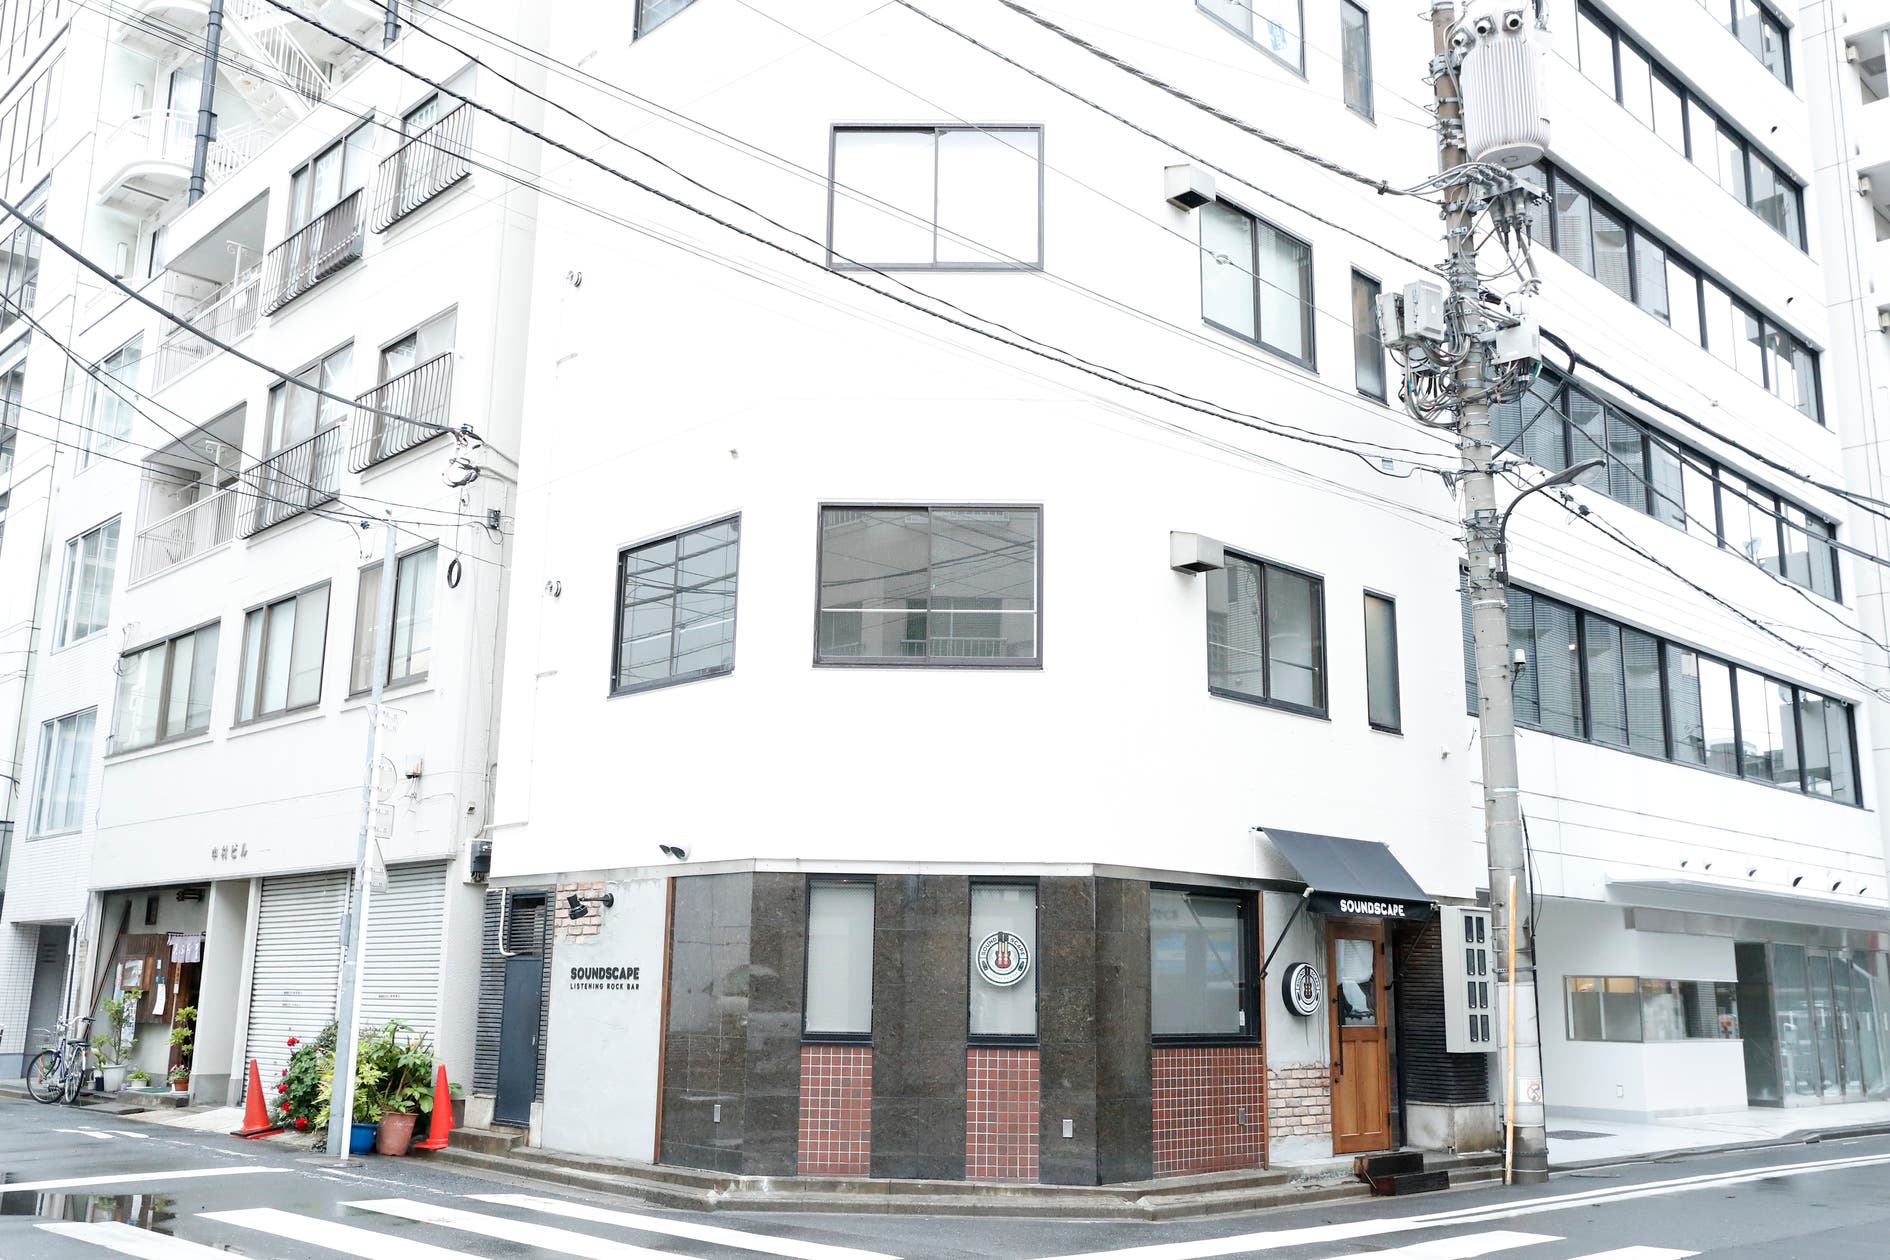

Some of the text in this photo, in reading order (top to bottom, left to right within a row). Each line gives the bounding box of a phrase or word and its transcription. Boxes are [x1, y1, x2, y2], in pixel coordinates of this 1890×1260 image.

[1340, 899, 1405, 917] SOUNDSCAPE
[981, 937, 1026, 956] SOUND SCAPE
[570, 967, 640, 980] SOUNDSCAPE
